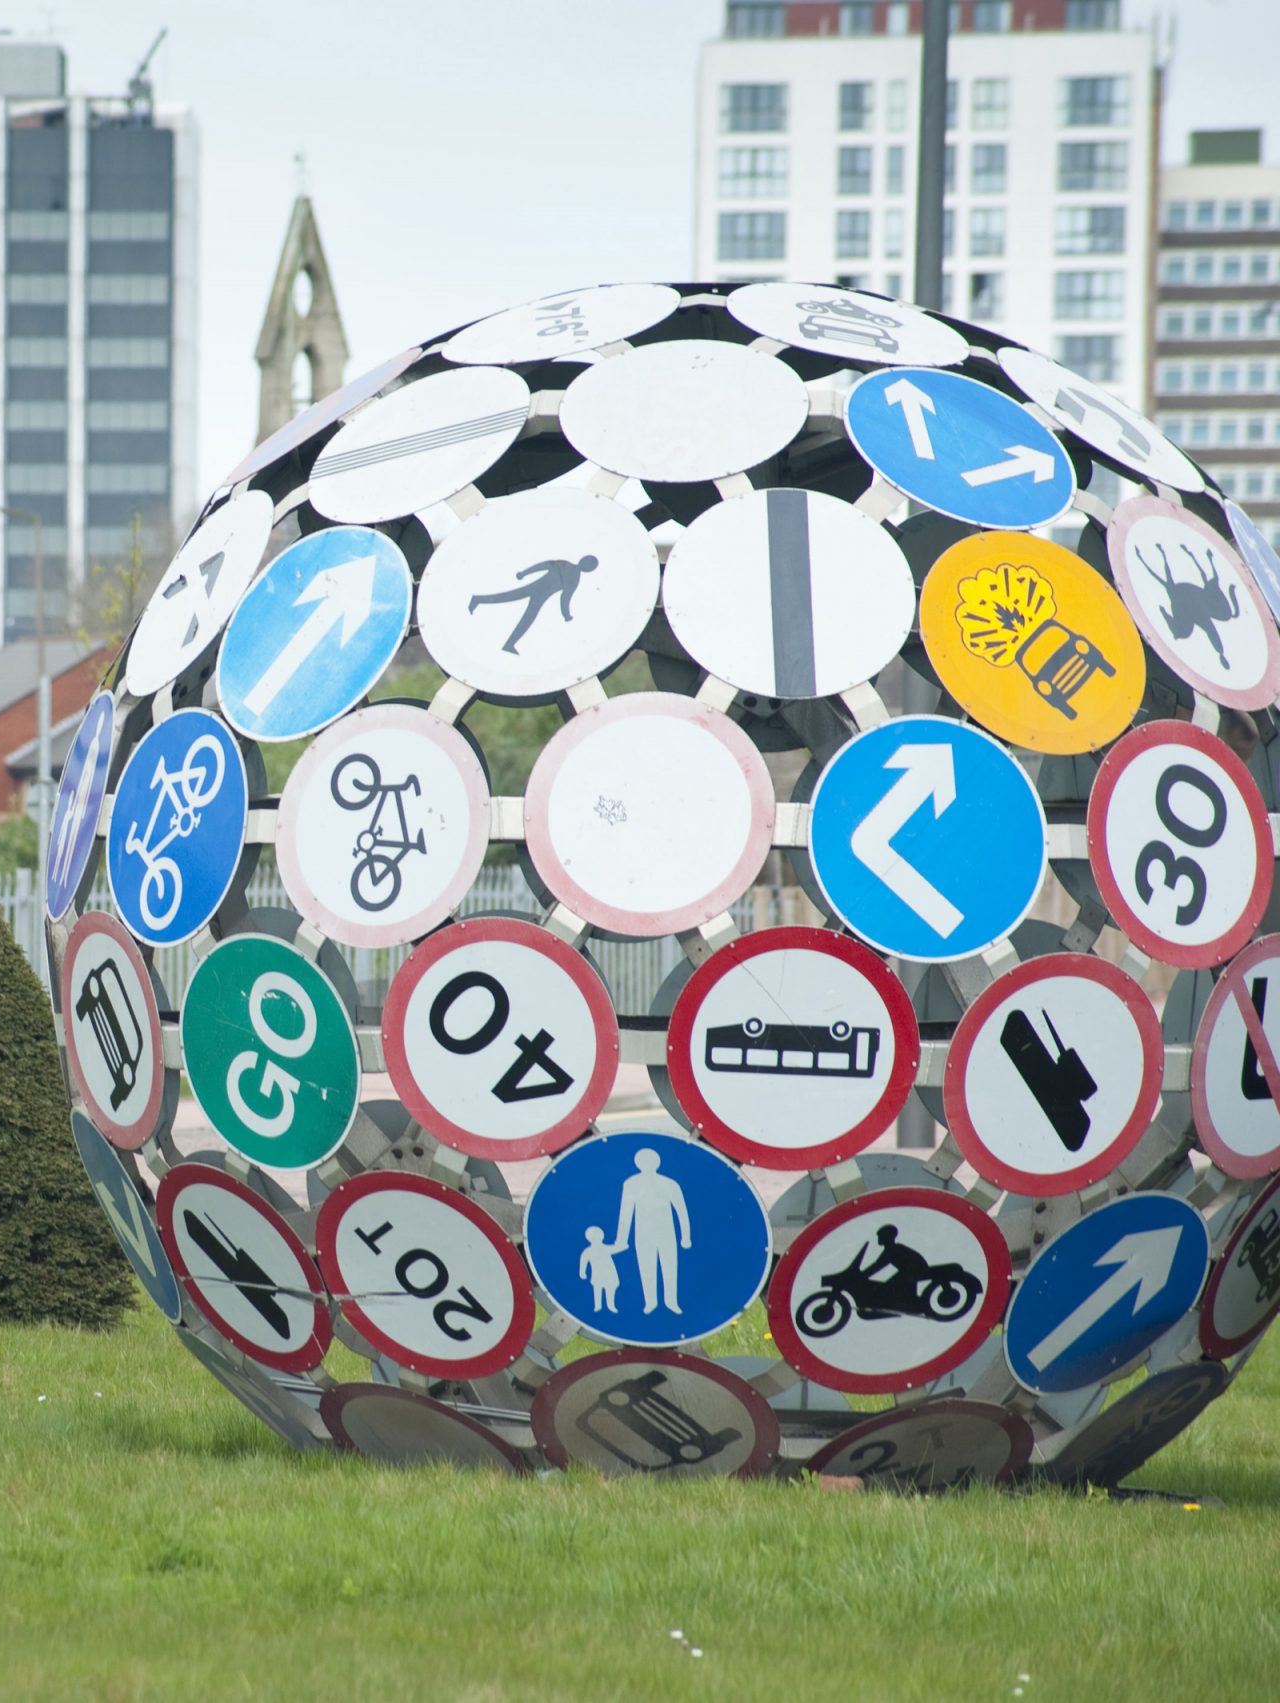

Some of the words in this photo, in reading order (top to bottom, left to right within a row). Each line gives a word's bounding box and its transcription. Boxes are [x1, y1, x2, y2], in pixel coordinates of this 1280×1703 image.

[1135, 764, 1227, 926] 30
[226, 971, 317, 1138] GO
[429, 971, 575, 1104] 40
[354, 1220, 493, 1342] 20T
